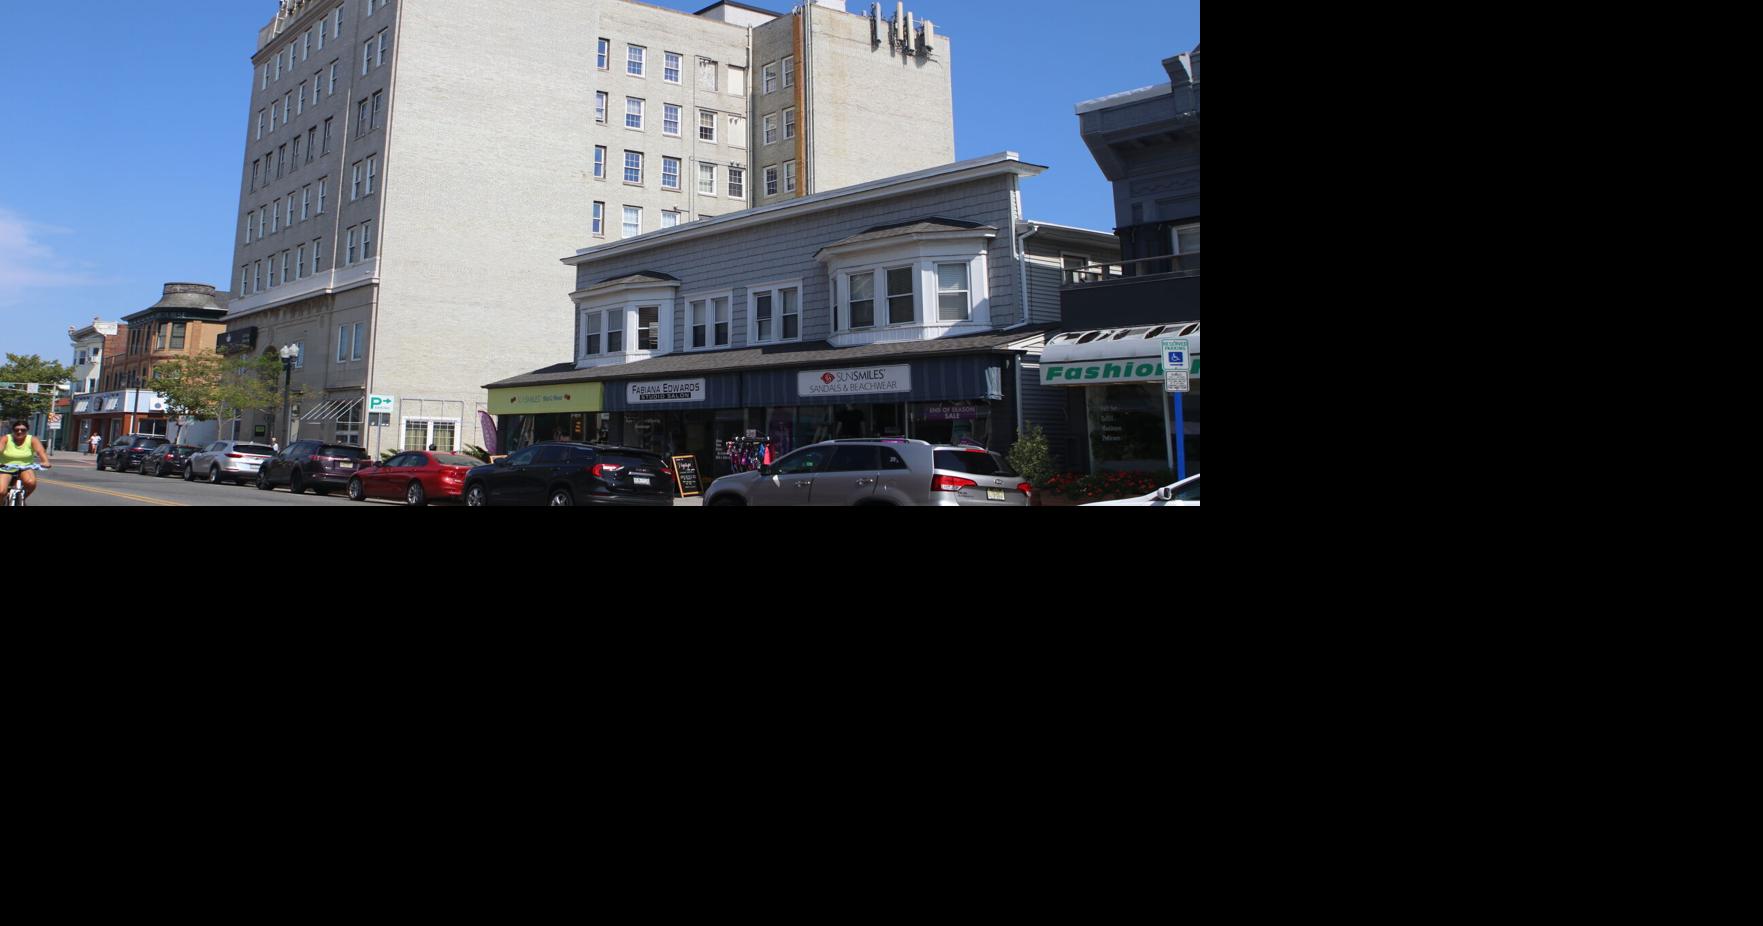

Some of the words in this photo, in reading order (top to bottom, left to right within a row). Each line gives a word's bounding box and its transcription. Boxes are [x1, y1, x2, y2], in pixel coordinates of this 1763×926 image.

[631, 384, 661, 394] FABIANA
[662, 382, 701, 393] EDWARDS
[808, 384, 841, 393] SANDALS
[843, 384, 849, 392] &
[850, 381, 897, 391] BEACHWEAR
[370, 397, 382, 409] P
